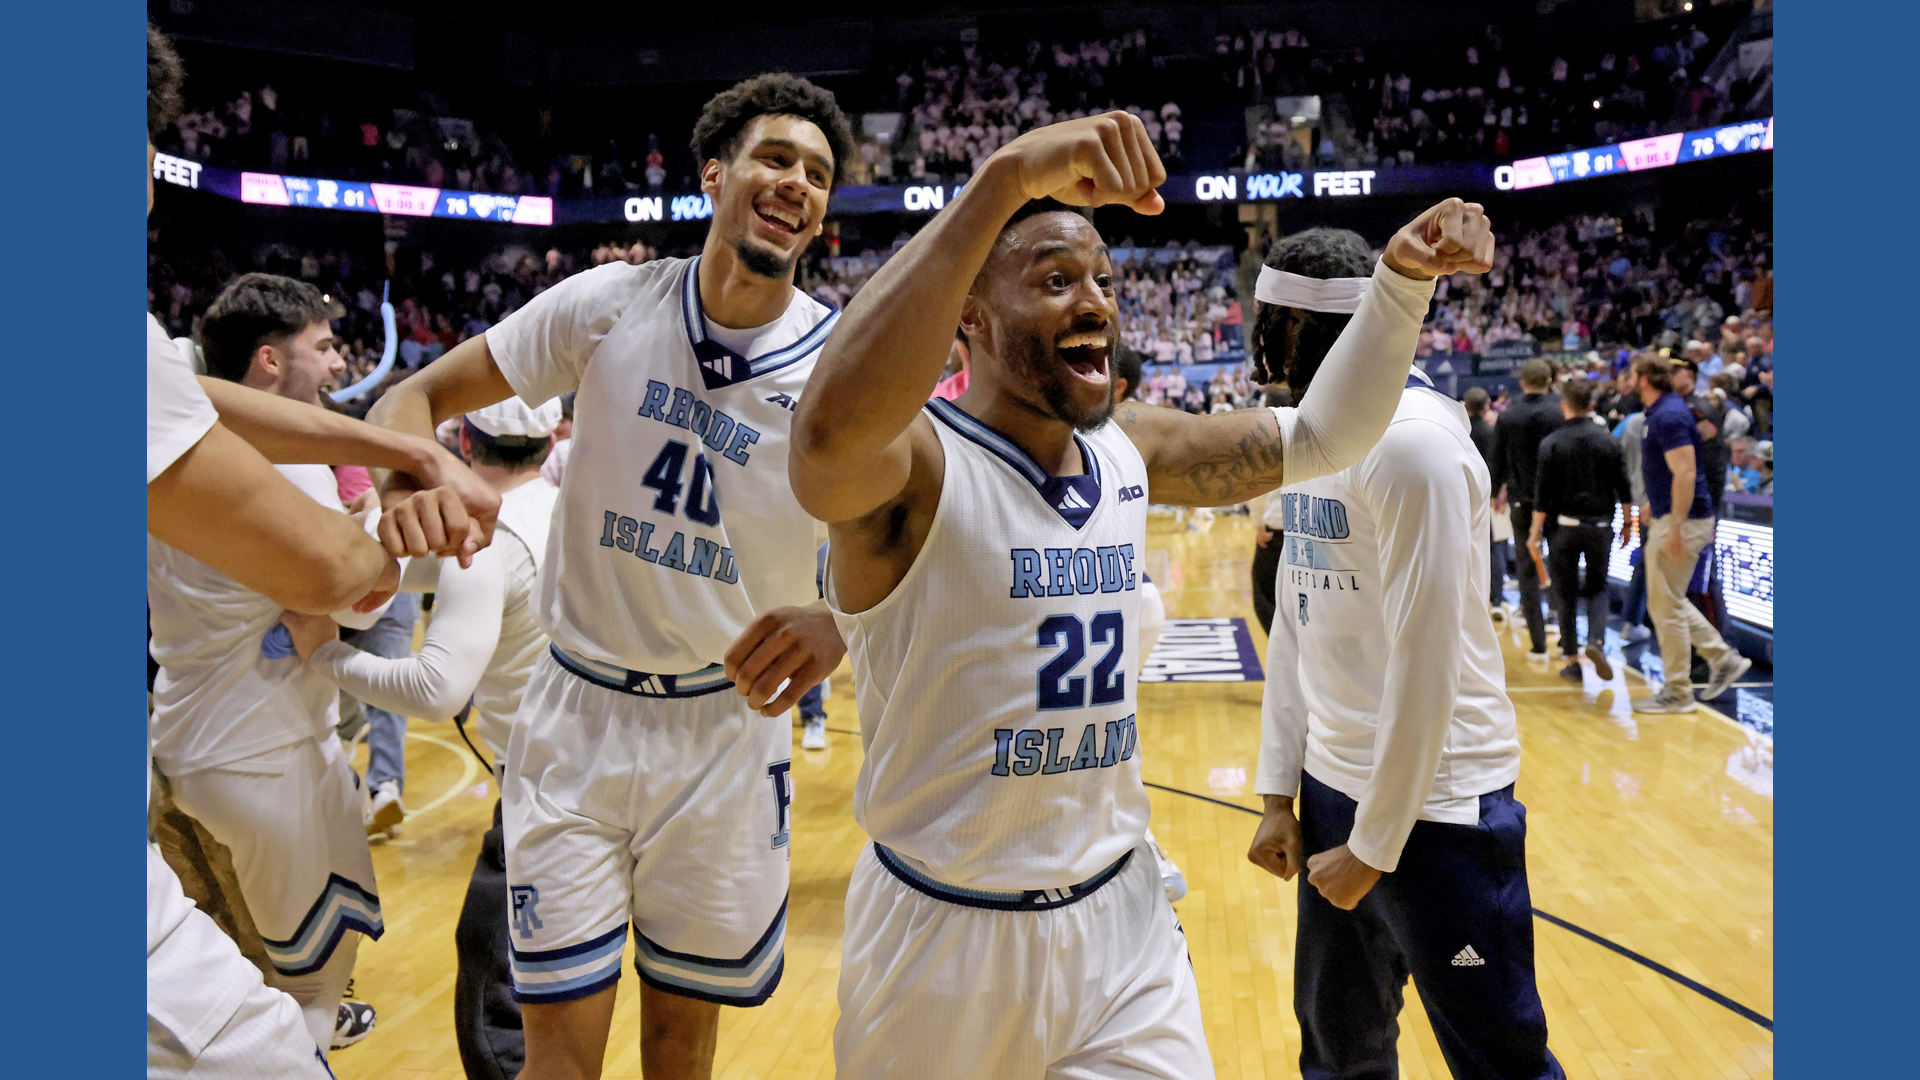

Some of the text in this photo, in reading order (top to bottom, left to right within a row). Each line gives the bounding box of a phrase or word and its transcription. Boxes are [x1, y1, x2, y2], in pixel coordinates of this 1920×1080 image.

[1692, 137, 1714, 156] 76
[153, 152, 203, 189] FEET
[1196, 170, 1376, 200] ON YOUR FEET
[344, 189, 365, 207] 81
[446, 198, 468, 216] 76
[624, 192, 714, 222] ON YOU
[904, 186, 944, 211] ON
[638, 379, 761, 467] RHODE
[640, 438, 721, 529] 40
[1300, 493, 1351, 540] ISLAND
[599, 510, 739, 585] ISLAND
[1010, 543, 1136, 599] RHODE
[1036, 609, 1125, 712] 22
[991, 713, 1138, 777] ISLAND
[1451, 958, 1486, 966] adidas
